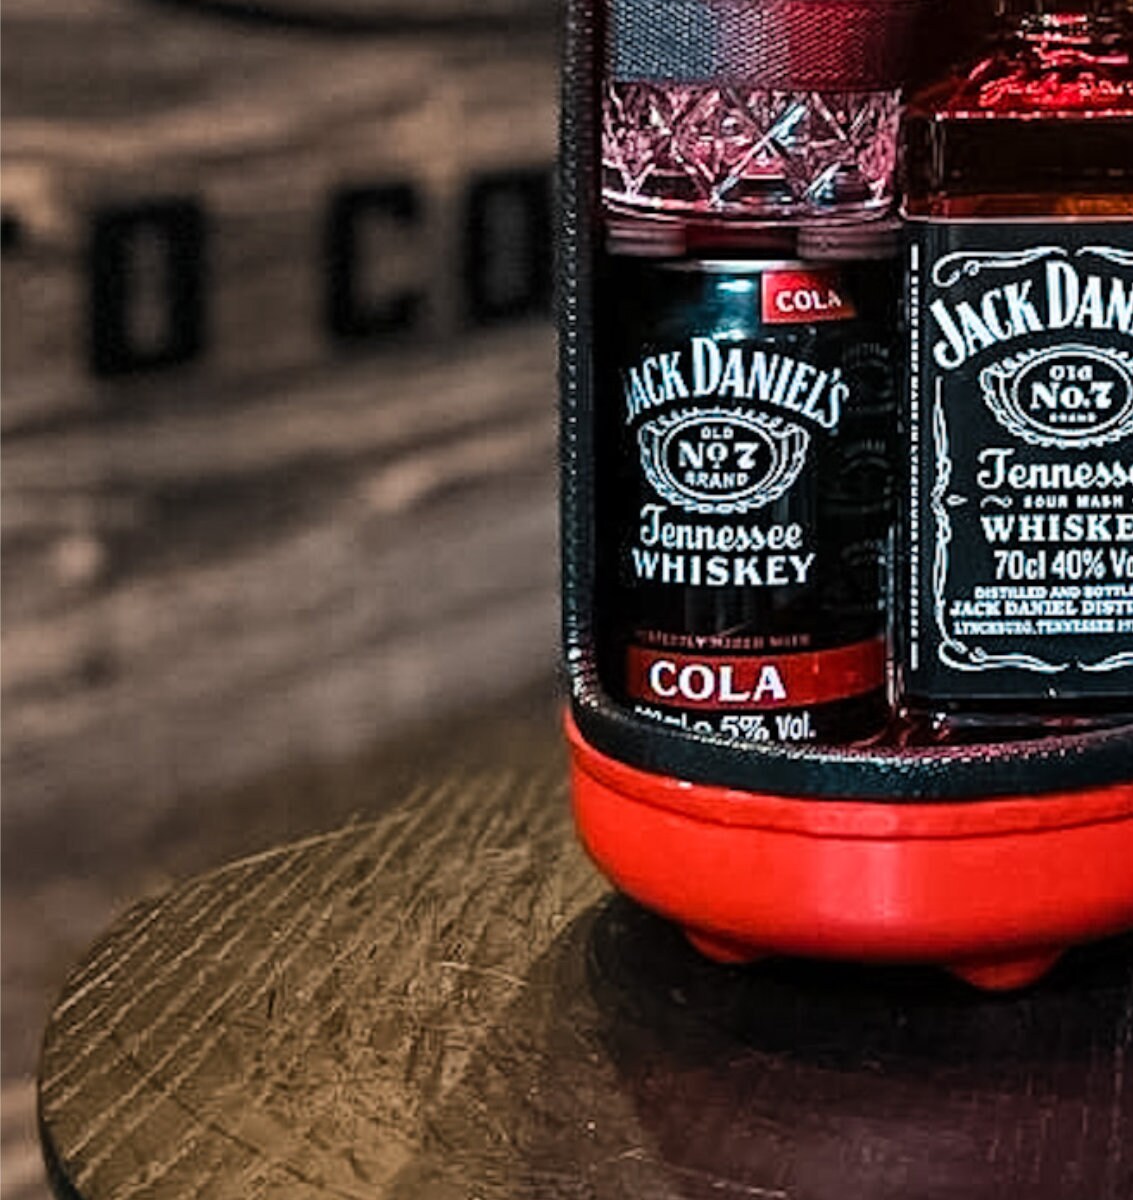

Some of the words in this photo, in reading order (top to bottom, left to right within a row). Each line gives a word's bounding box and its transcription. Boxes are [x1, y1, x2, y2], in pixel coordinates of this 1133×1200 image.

[775, 289, 843, 313] COLA
[930, 279, 1044, 370] JACK
[691, 336, 851, 429] DANIEL'S
[1029, 381, 1115, 410] No.7
[700, 425, 734, 440] OLD
[683, 470, 750, 489] BRAND
[639, 503, 804, 551] Tennessee
[631, 548, 817, 586] WHISKEY
[993, 548, 1047, 581] 70cl
[1051, 548, 1107, 580] 40%
[950, 600, 1002, 617] JACK
[1004, 599, 1079, 616] DANIEL
[1048, 585, 1082, 599] AND
[649, 659, 788, 703] COLA
[719, 714, 771, 743] 5%
[775, 709, 818, 741] Vol.
